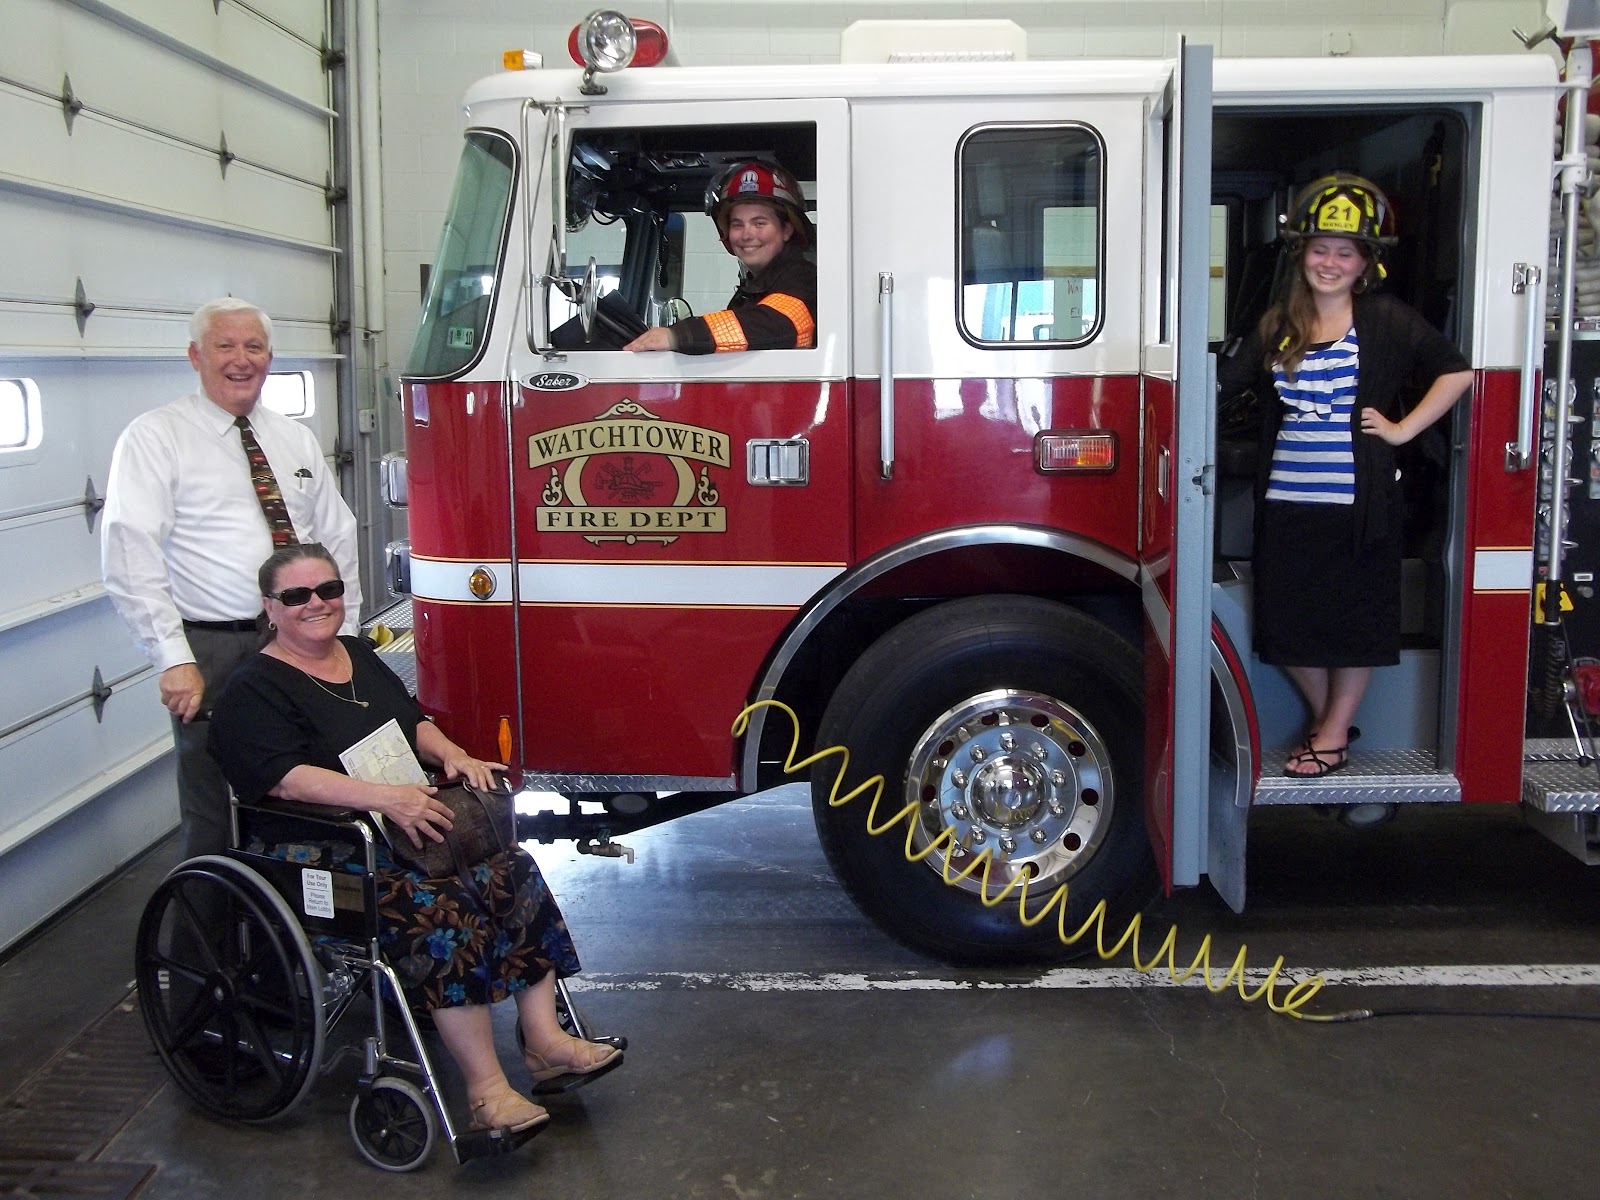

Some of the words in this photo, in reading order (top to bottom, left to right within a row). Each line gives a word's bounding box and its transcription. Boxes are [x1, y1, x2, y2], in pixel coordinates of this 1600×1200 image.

[1326, 205, 1352, 221] 21
[535, 374, 572, 387] Saber
[534, 425, 725, 460] WATCHTOWER
[546, 511, 618, 528] FIRE
[630, 511, 717, 528] DEPT
[316, 881, 328, 889] Only
